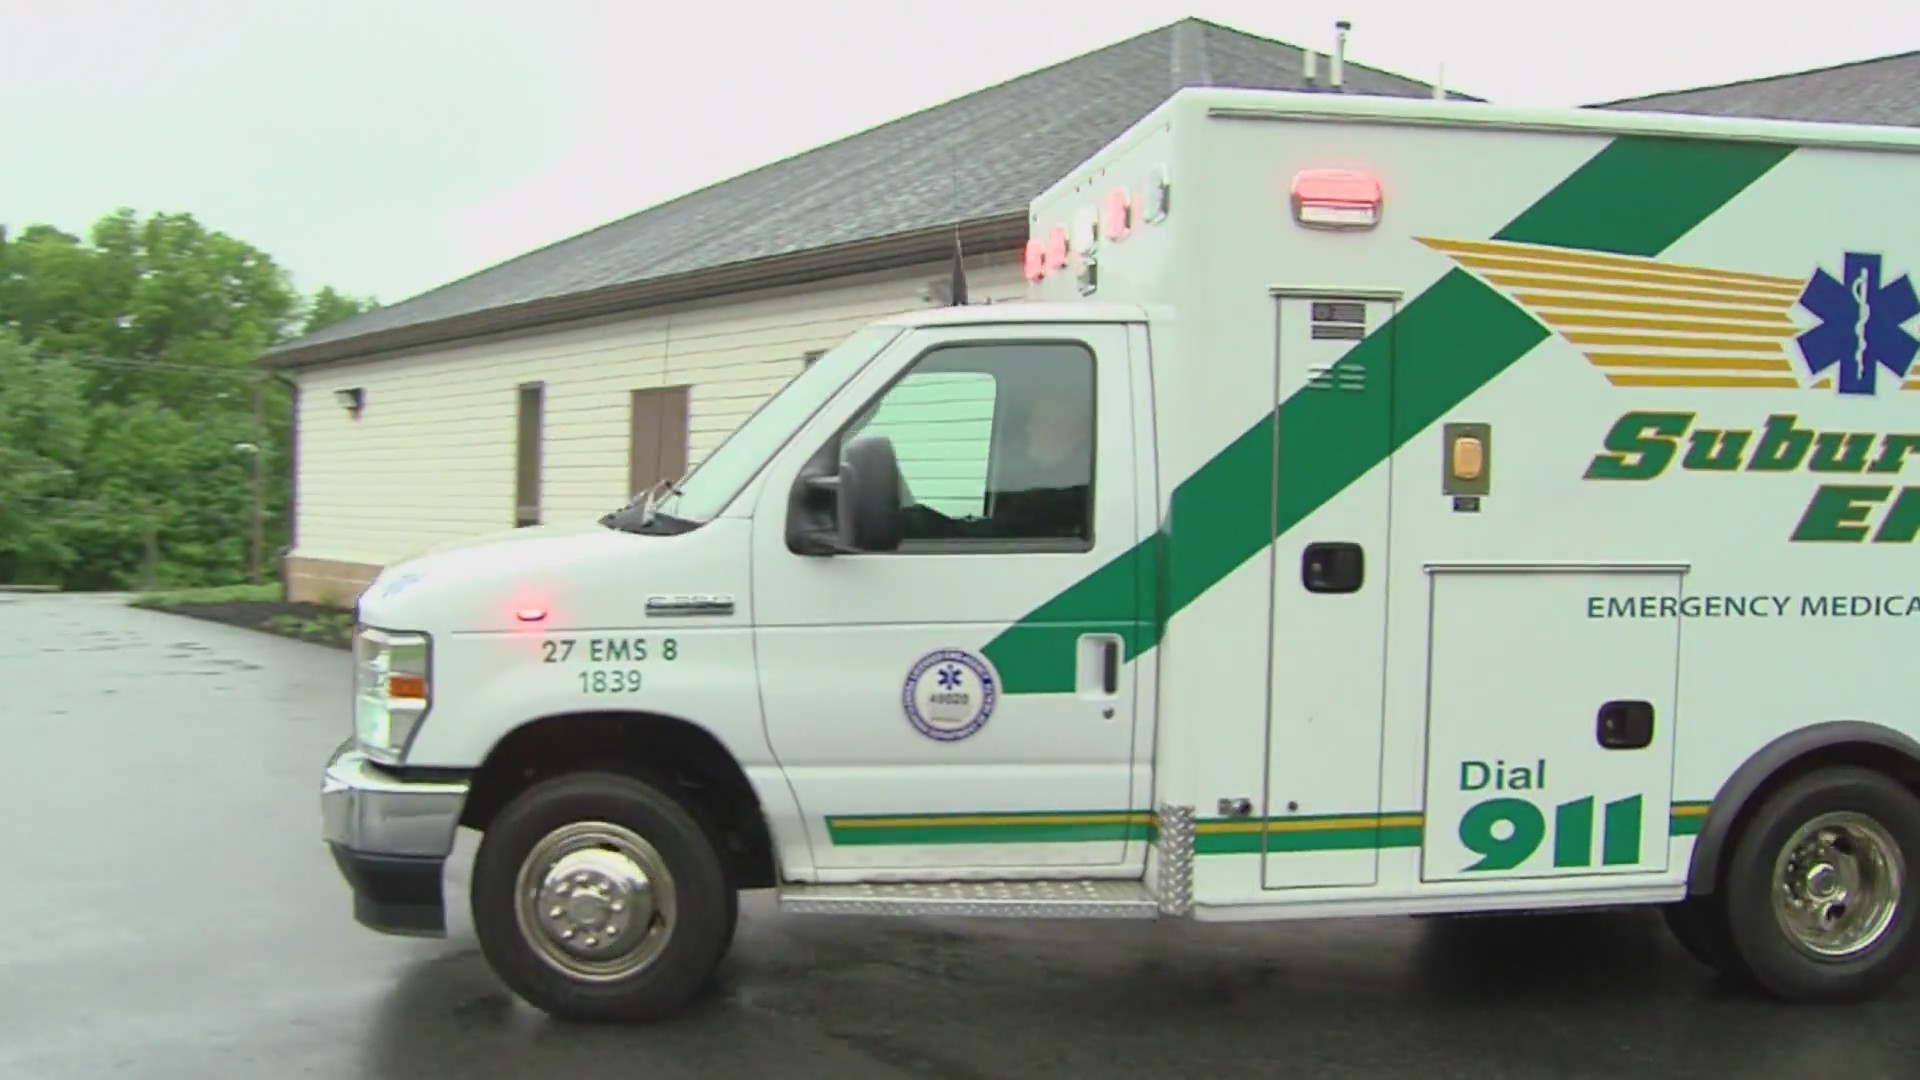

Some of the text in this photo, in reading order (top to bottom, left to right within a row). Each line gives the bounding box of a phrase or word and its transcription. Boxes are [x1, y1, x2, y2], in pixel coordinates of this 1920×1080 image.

[1587, 596, 1790, 618] EMERGENCY
[542, 638, 678, 663] 27 EMS 8
[578, 670, 642, 693] 1839
[1459, 758, 1546, 791] Dial
[1458, 793, 1643, 872] 911
